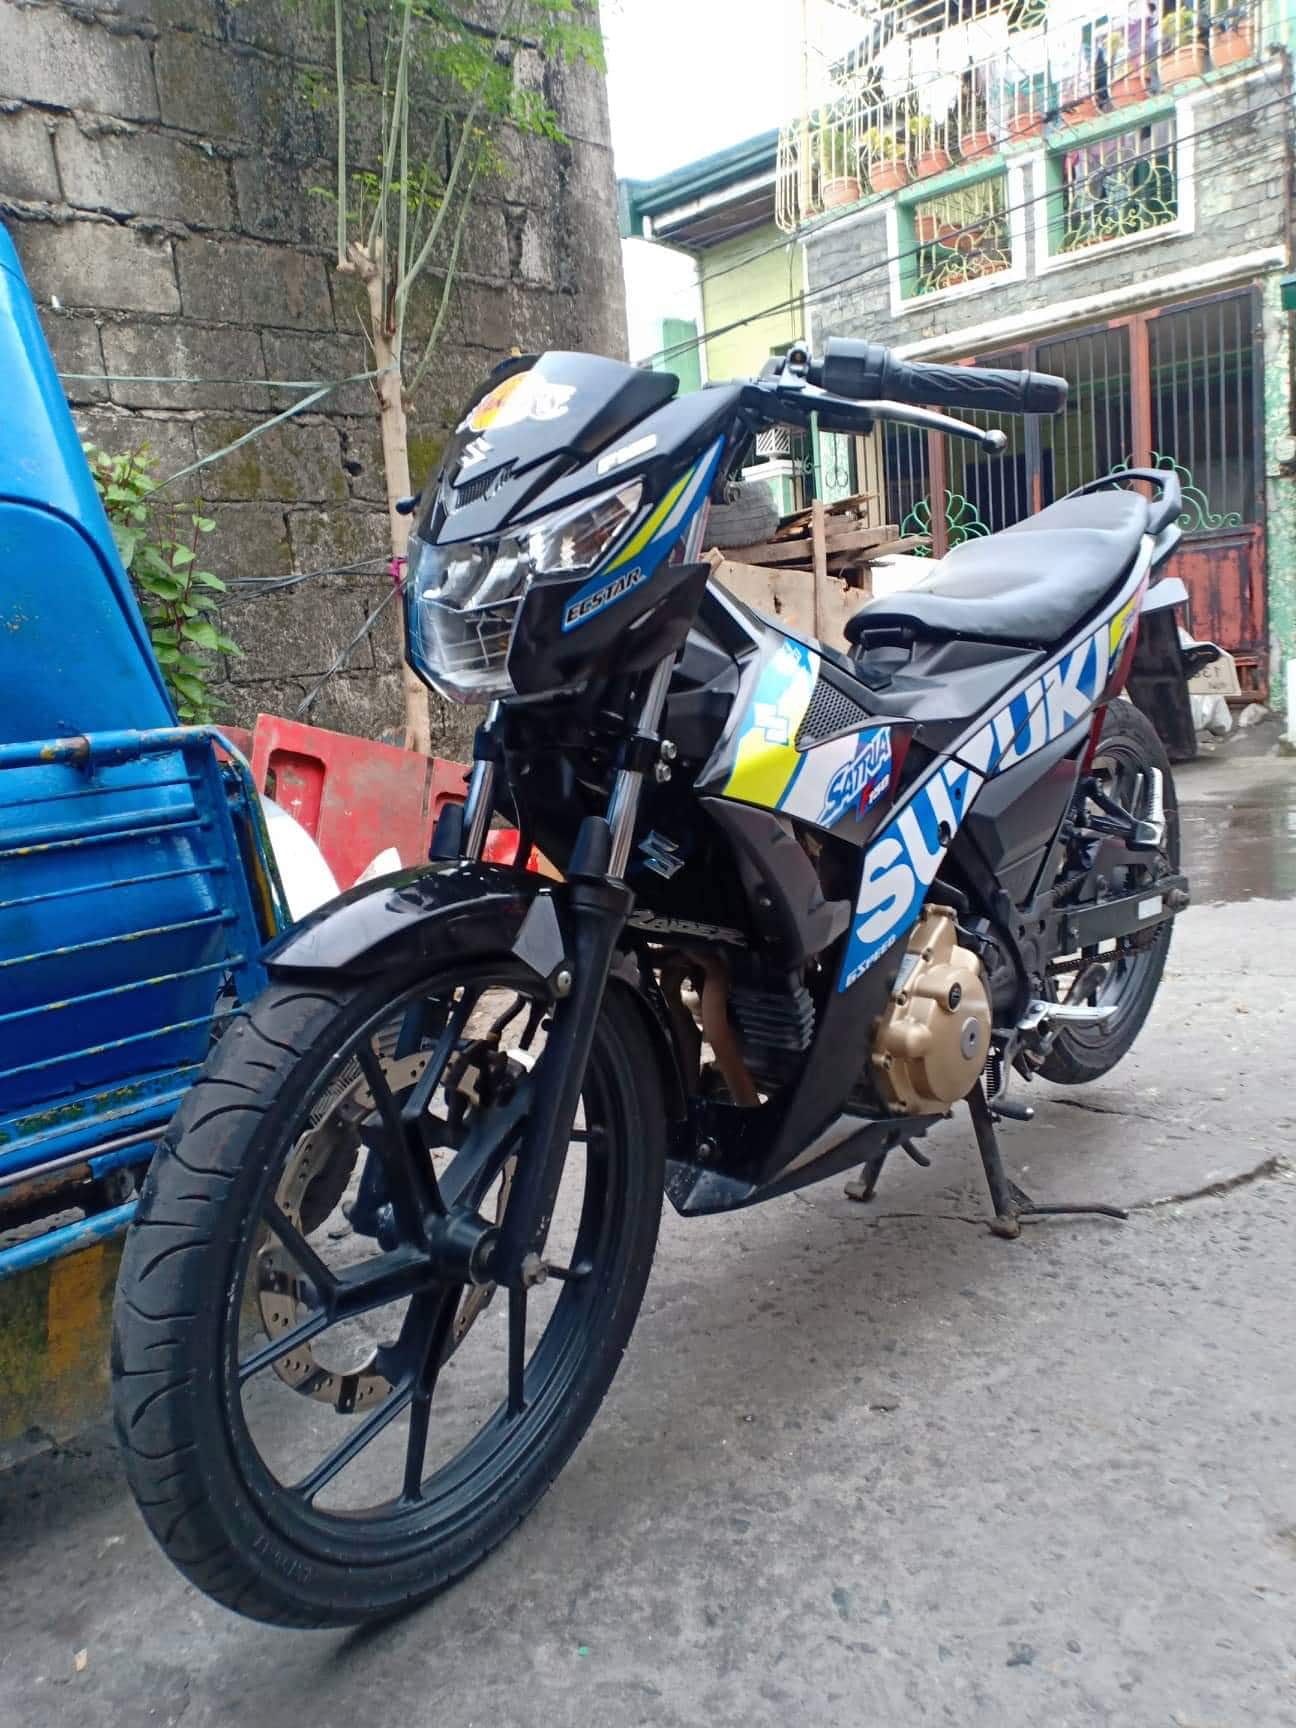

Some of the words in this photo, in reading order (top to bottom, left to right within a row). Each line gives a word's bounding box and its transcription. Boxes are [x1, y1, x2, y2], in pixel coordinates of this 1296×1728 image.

[565, 566, 648, 627] ECSTAR
[816, 726, 892, 828] SATRIA
[856, 624, 1109, 943] SUZUKI
